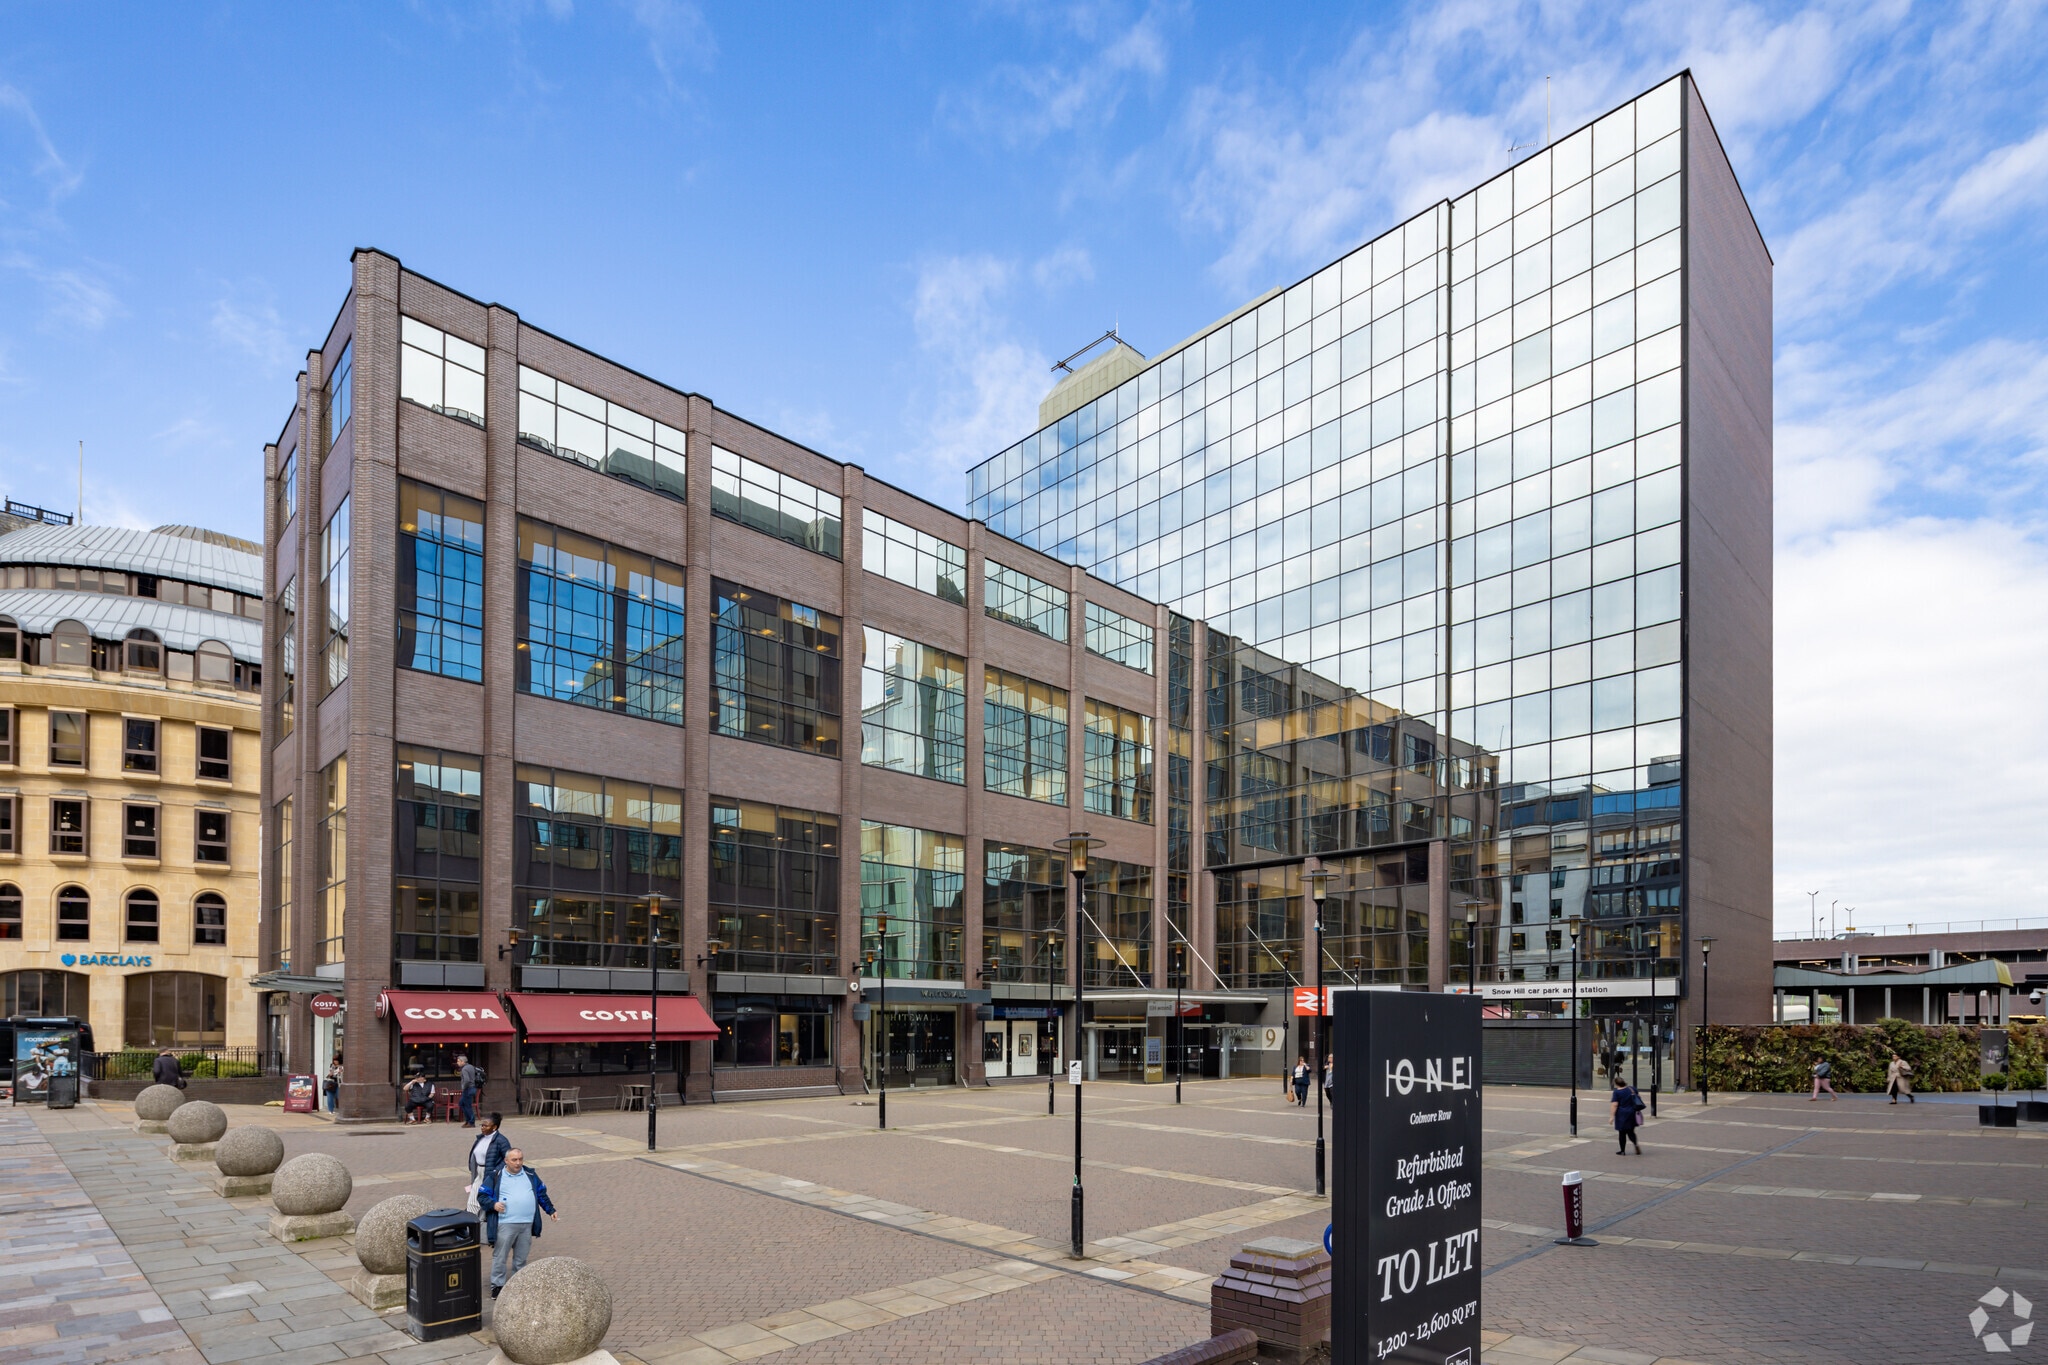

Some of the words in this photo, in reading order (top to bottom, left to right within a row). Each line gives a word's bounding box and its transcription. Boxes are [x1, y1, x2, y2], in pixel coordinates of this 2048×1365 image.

[79, 954, 152, 967] BARCLAYS
[1543, 987, 1559, 995] park
[1580, 985, 1608, 993] station
[404, 1008, 500, 1021] COSTA
[579, 1010, 658, 1022] COSTA
[884, 1013, 941, 1022] HITEWALL
[1265, 1028, 1277, 1048] 9
[1395, 1056, 1465, 1095] ONE
[1410, 1112, 1437, 1125] Colmore
[1438, 1109, 1452, 1121] Row
[1396, 1146, 1464, 1184] Refurbished
[1386, 1188, 1424, 1218] Grade
[1425, 1187, 1435, 1208] A
[1437, 1180, 1472, 1210] Offices
[1377, 1248, 1421, 1302] TO
[1426, 1228, 1479, 1286] LET
[1377, 1331, 1408, 1360] 1,200
[1416, 1312, 1450, 1341] 12,600
[1451, 1306, 1464, 1325] SQ
[1464, 1300, 1477, 1319] FT
